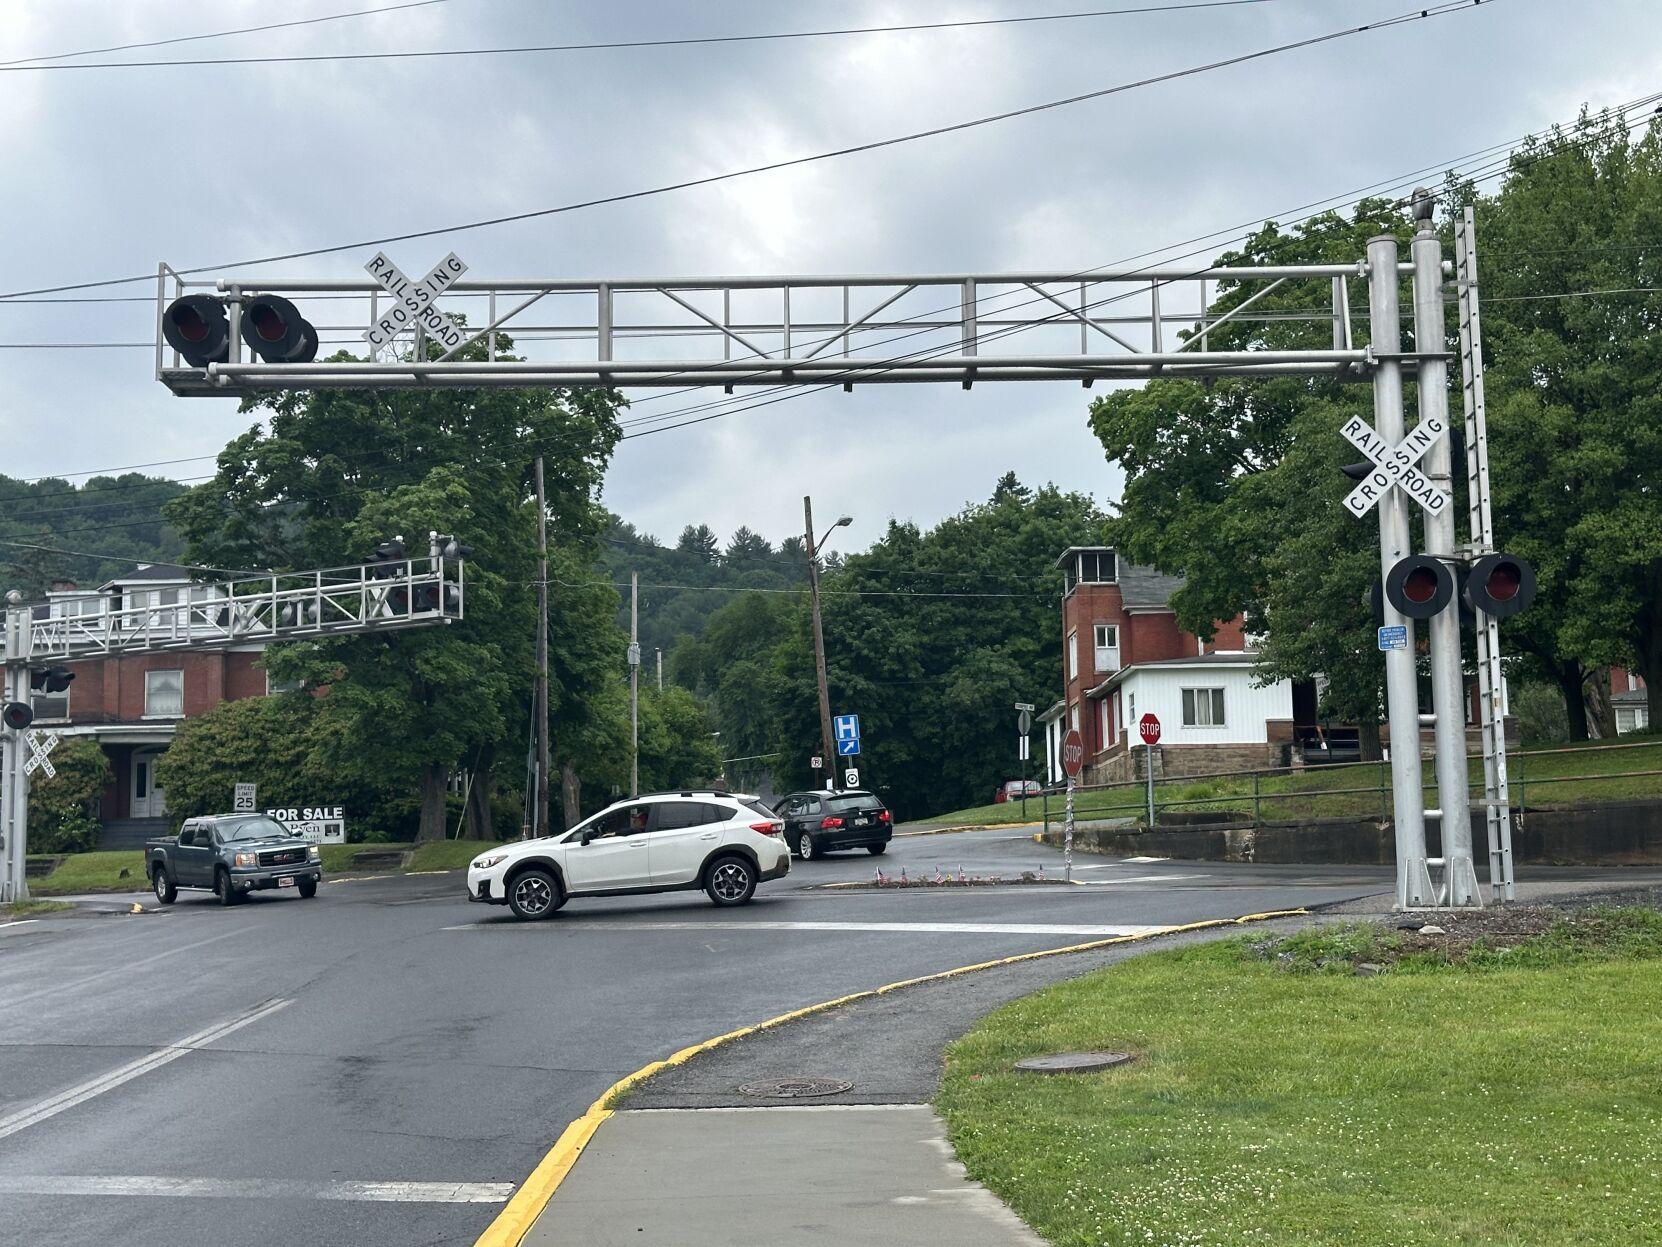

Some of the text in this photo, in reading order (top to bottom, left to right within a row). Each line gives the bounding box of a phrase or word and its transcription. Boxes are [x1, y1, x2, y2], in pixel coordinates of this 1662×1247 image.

[369, 258, 462, 345] CROSSING
[1350, 418, 1443, 511] CROSSING
[837, 717, 856, 739] H
[1140, 723, 1160, 735] STOP
[25, 736, 57, 773] CROSSING
[1065, 744, 1081, 762] STOP
[236, 797, 253, 808] 25
[266, 807, 343, 820] FOR SALE
